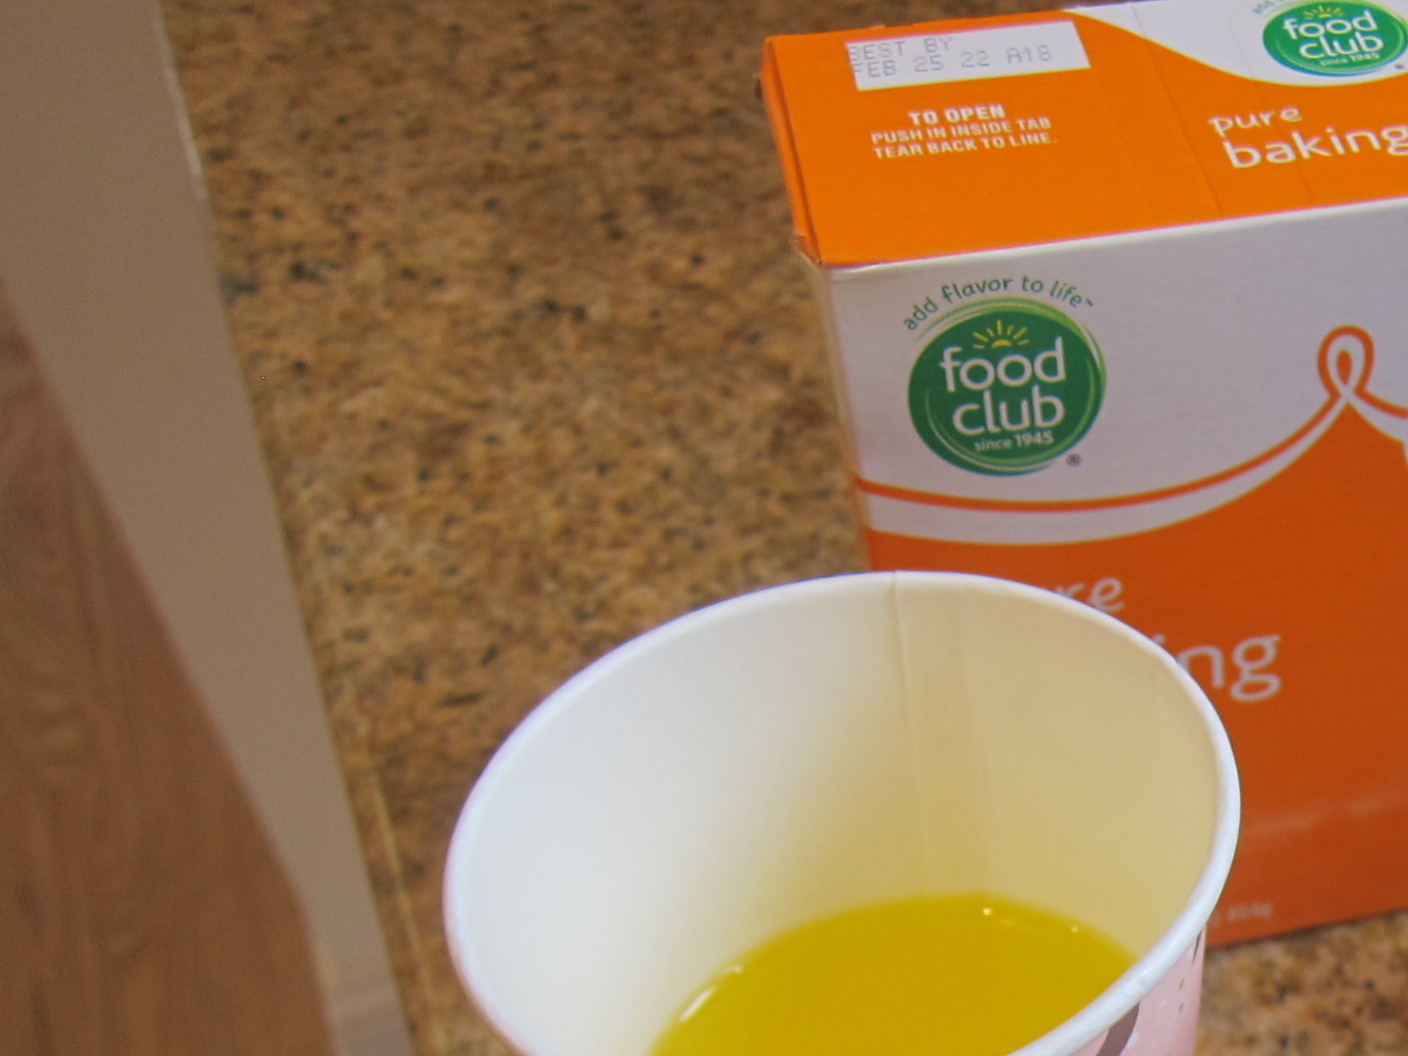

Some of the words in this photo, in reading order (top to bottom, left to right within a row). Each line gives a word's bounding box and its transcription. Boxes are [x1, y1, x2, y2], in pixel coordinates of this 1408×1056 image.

[1282, 8, 1379, 39] food
[923, 36, 955, 54] BY
[1298, 30, 1384, 60] club
[914, 54, 945, 73] 25
[960, 50, 991, 68] 22
[908, 109, 940, 126] TO
[944, 103, 1007, 123] OPEN
[1208, 107, 1303, 138] pure
[870, 128, 924, 145] PUSH
[926, 125, 948, 140] IN
[951, 121, 1013, 138] INSIDE
[1015, 116, 1053, 131] TAB
[872, 143, 925, 160] TEAR
[926, 137, 978, 155] BACK
[981, 135, 1007, 150] TO
[903, 296, 939, 331] add
[940, 277, 1013, 304] flavor
[1020, 275, 1044, 294] to
[939, 335, 1067, 393] food
[952, 383, 1066, 436] club
[973, 438, 1013, 452] since
[1014, 430, 1055, 447] 1945
